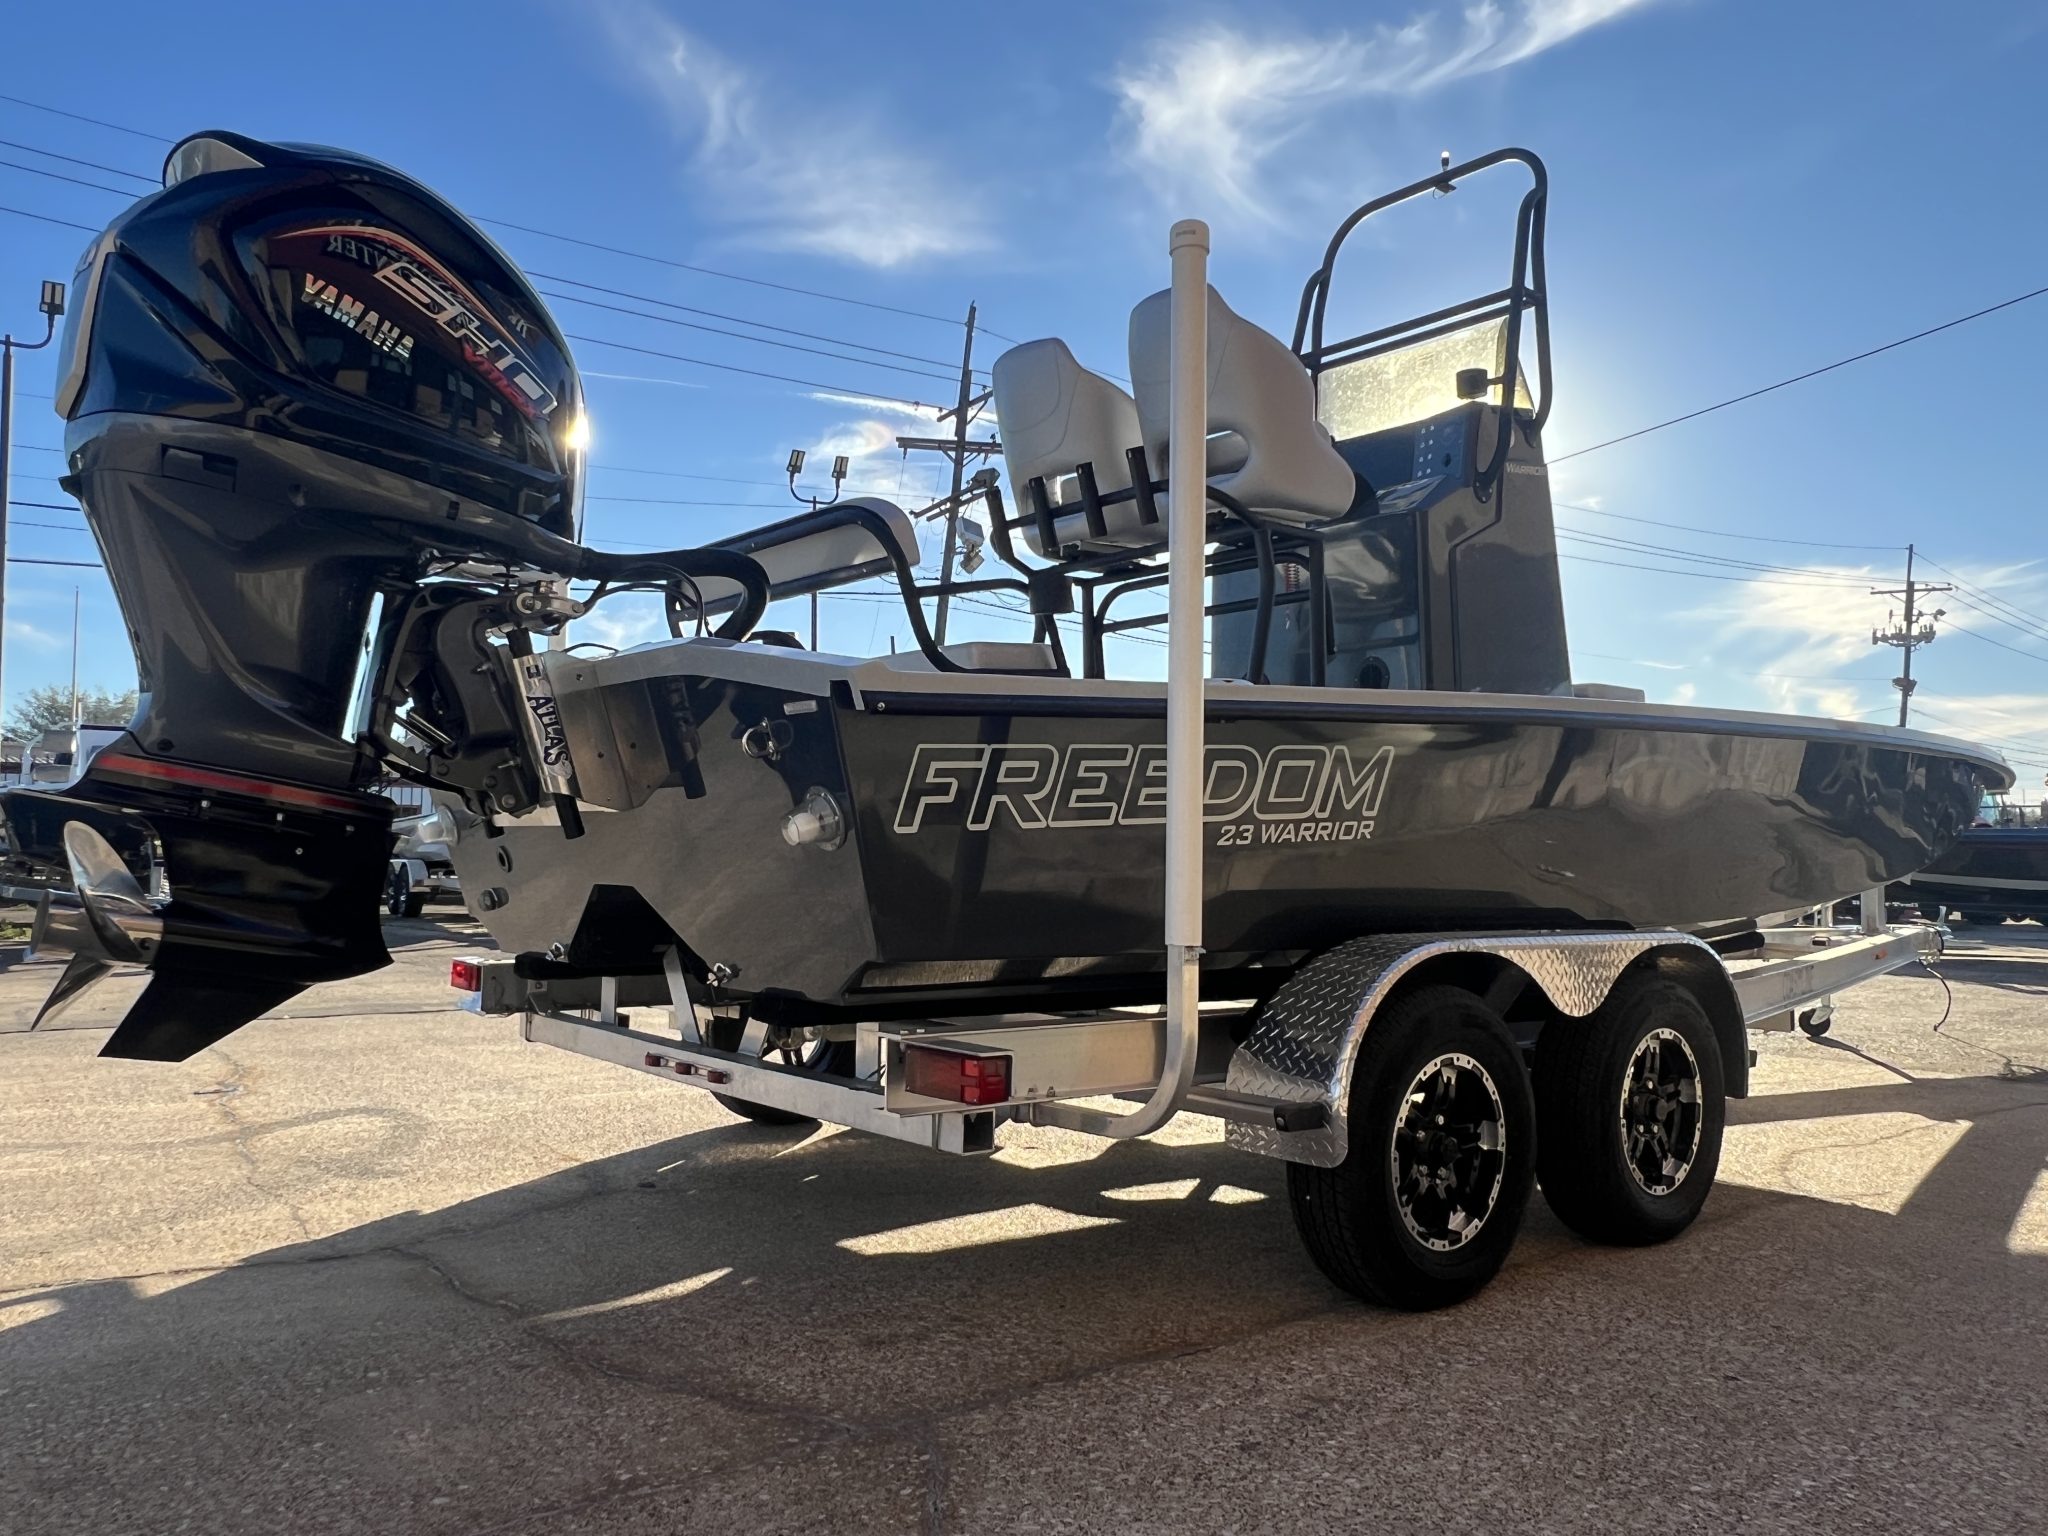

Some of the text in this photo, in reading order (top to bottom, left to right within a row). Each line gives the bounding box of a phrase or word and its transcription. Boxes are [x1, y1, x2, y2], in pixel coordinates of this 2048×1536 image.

[301, 272, 415, 358] YAMAHA
[526, 695, 569, 767] ATLAS
[893, 743, 1396, 834] FREEDOM
[1216, 820, 1376, 846] 23 WARRIOR
